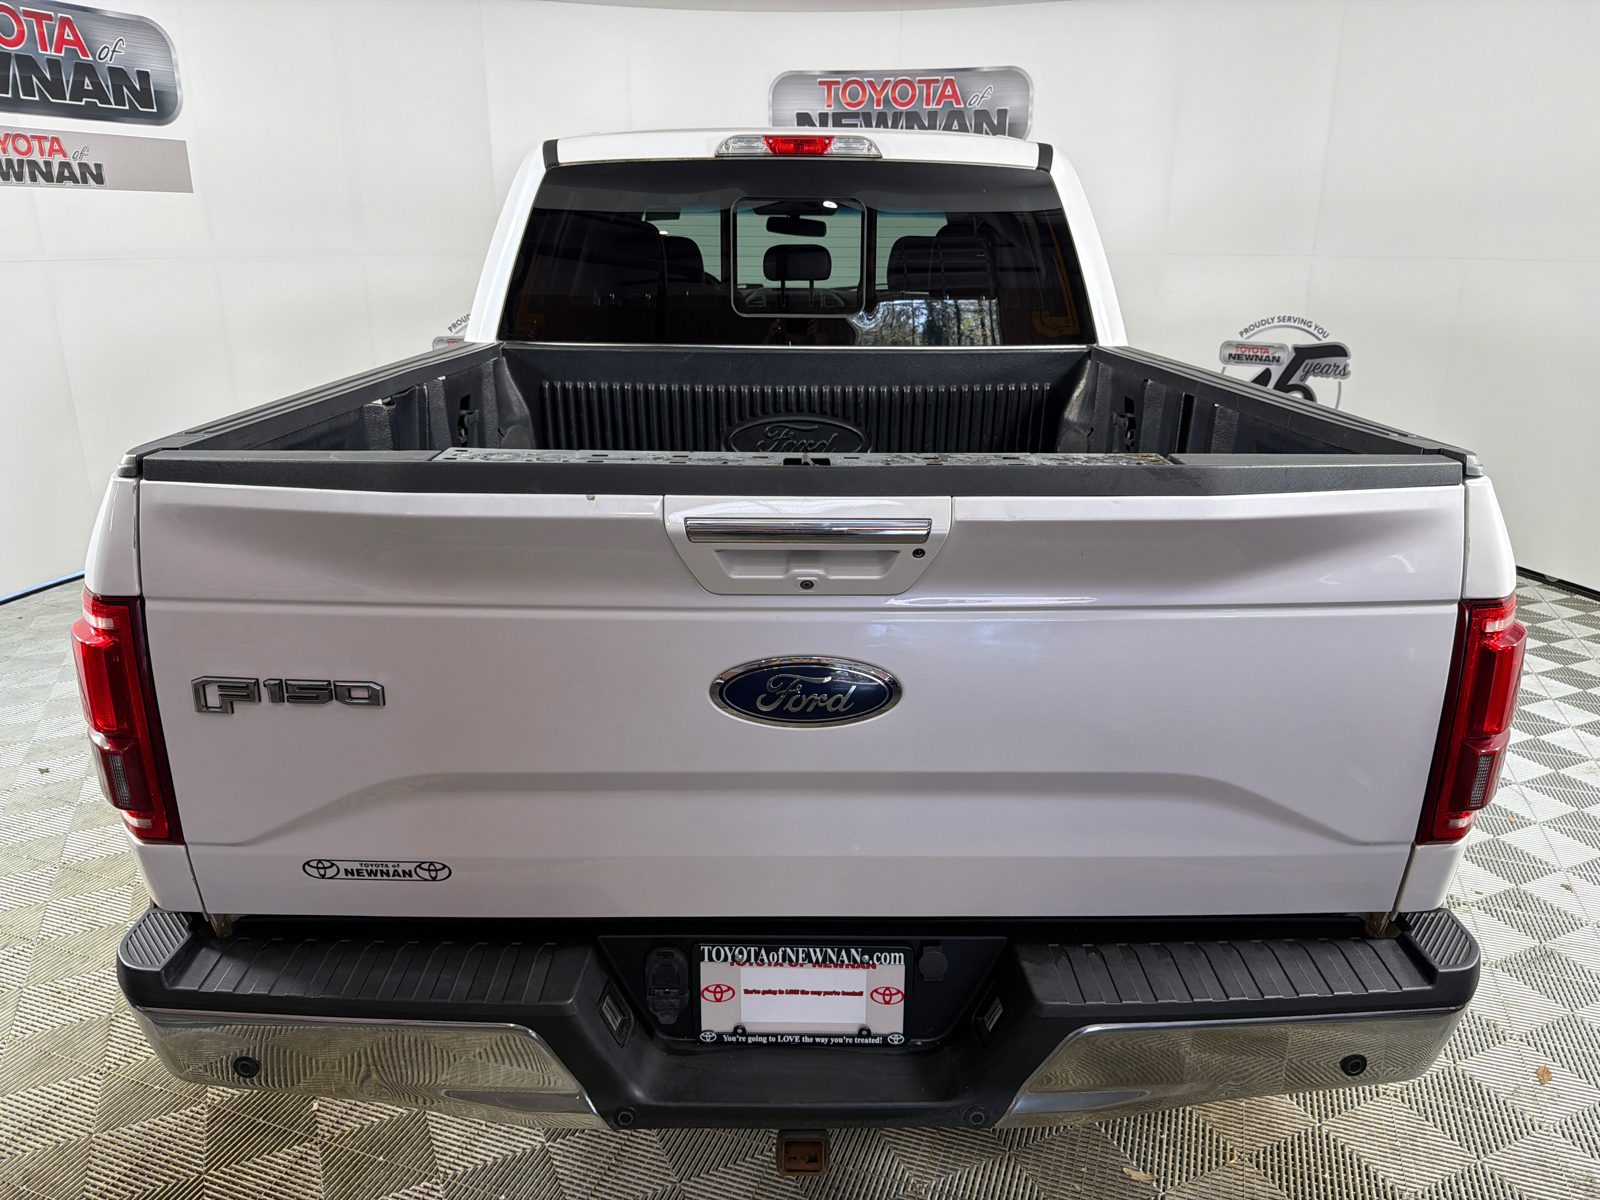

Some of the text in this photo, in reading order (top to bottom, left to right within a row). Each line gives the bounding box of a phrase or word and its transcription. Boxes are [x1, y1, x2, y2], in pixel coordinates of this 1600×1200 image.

[97, 38, 125, 62] of
[818, 77, 993, 109] TOYOTA of
[71, 146, 88, 160] of
[1238, 315, 1330, 339] PROUDLY SERVING YOU
[1227, 353, 1281, 363] NEWNAN
[1235, 345, 1270, 354] TOYOTA
[1299, 361, 1350, 382] years
[756, 423, 838, 452] Ford
[755, 673, 857, 713] Ford
[343, 868, 413, 878] NEWNAN
[723, 1034, 746, 1042] You're
[747, 1036, 767, 1044] going
[777, 1035, 800, 1043] LOVE
[830, 1036, 853, 1044] you're
